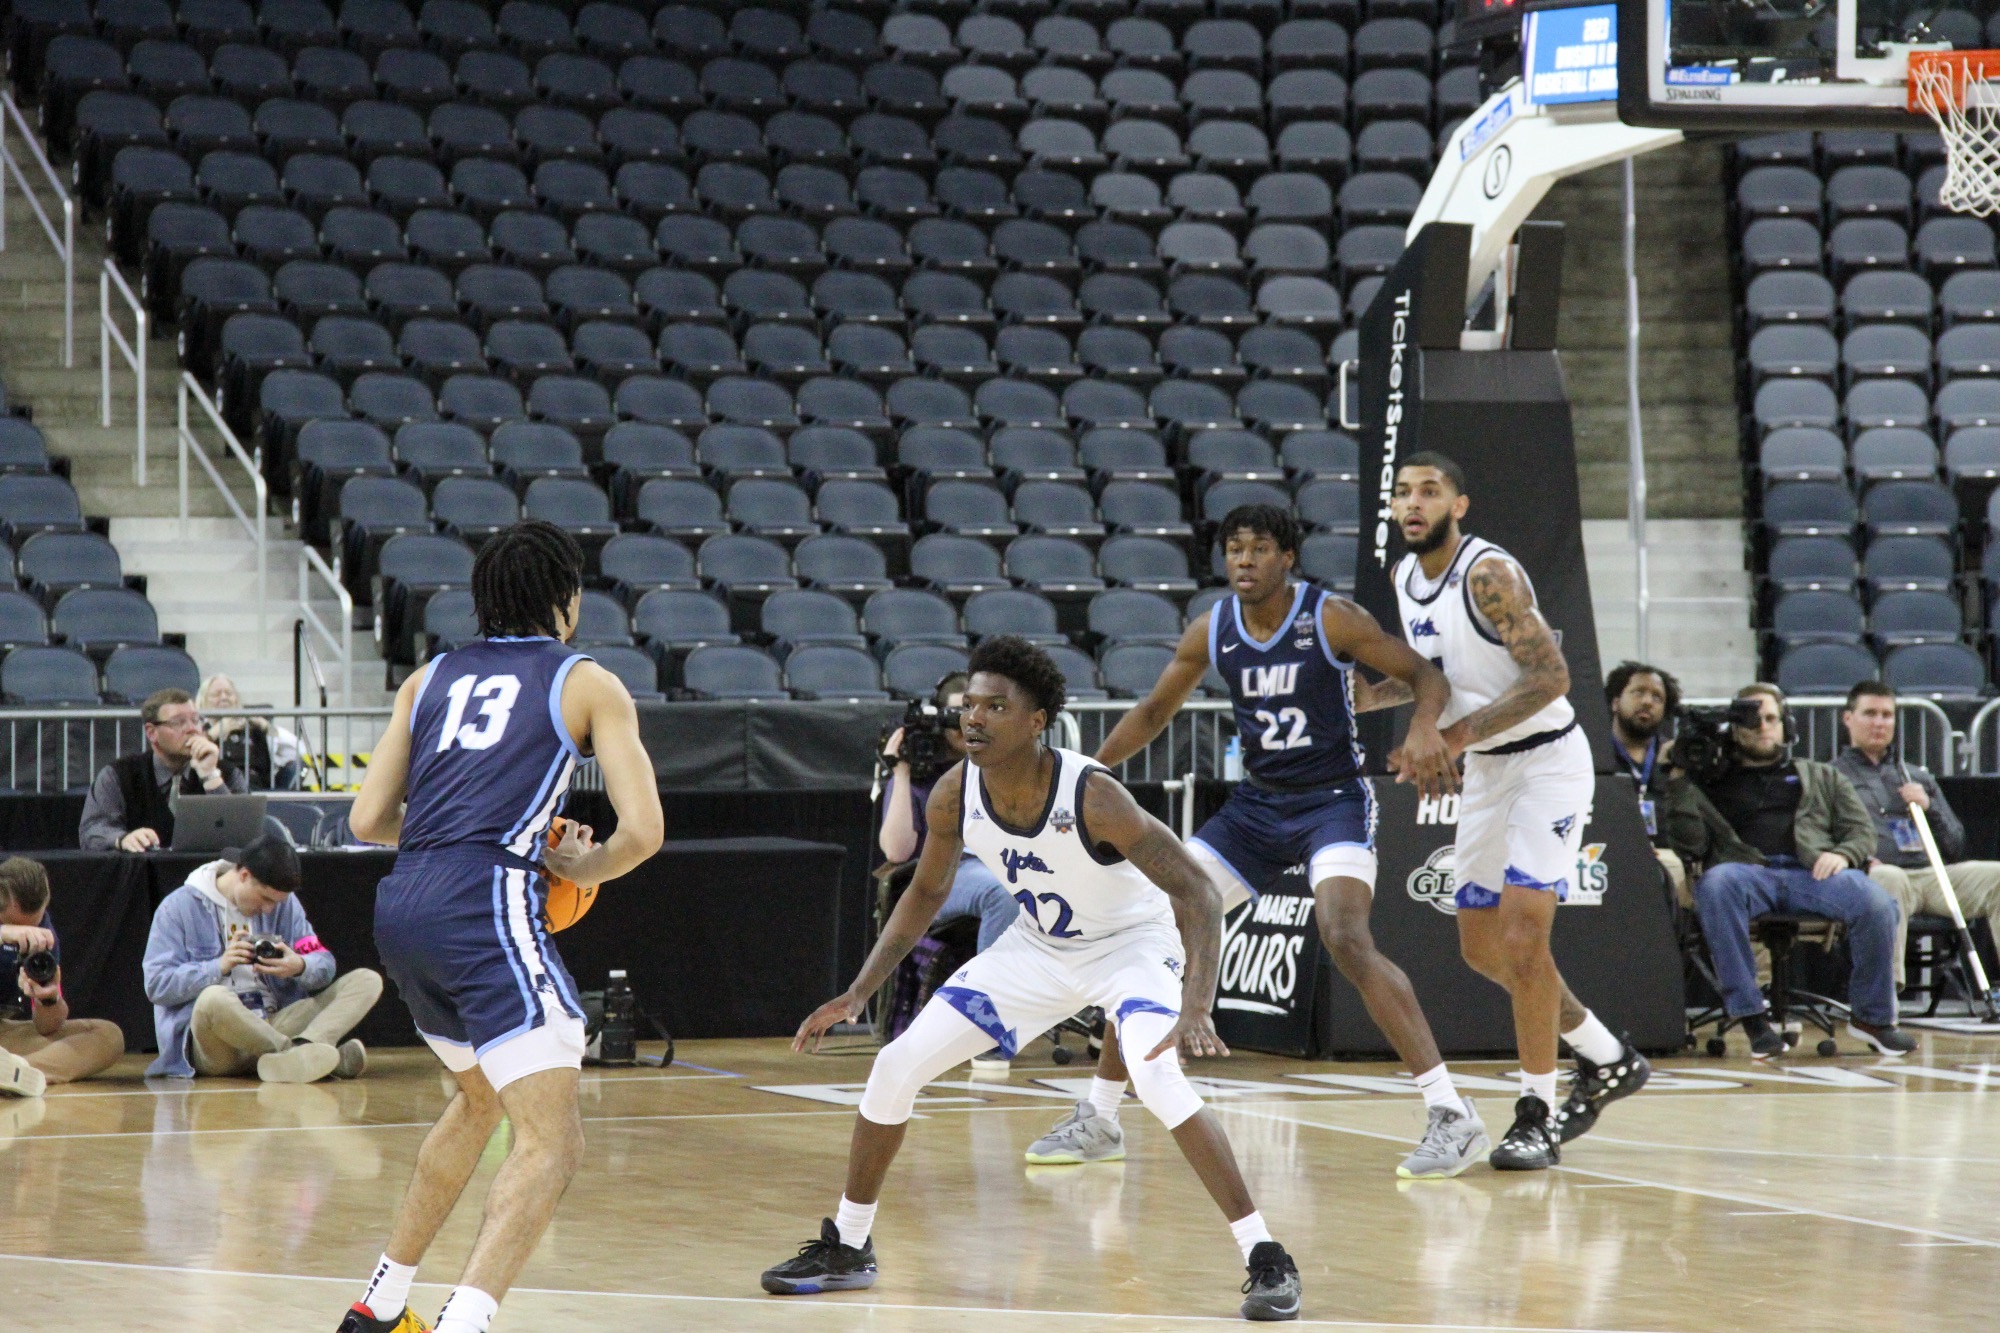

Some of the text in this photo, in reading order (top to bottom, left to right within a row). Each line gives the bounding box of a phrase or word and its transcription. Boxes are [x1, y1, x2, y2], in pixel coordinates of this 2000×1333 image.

[1665, 87, 1722, 101] SPALDING
[1241, 662, 1304, 699] LMU
[435, 674, 522, 753] 13
[1254, 706, 1313, 751] 22
[1252, 894, 1315, 927] MAKE IT
